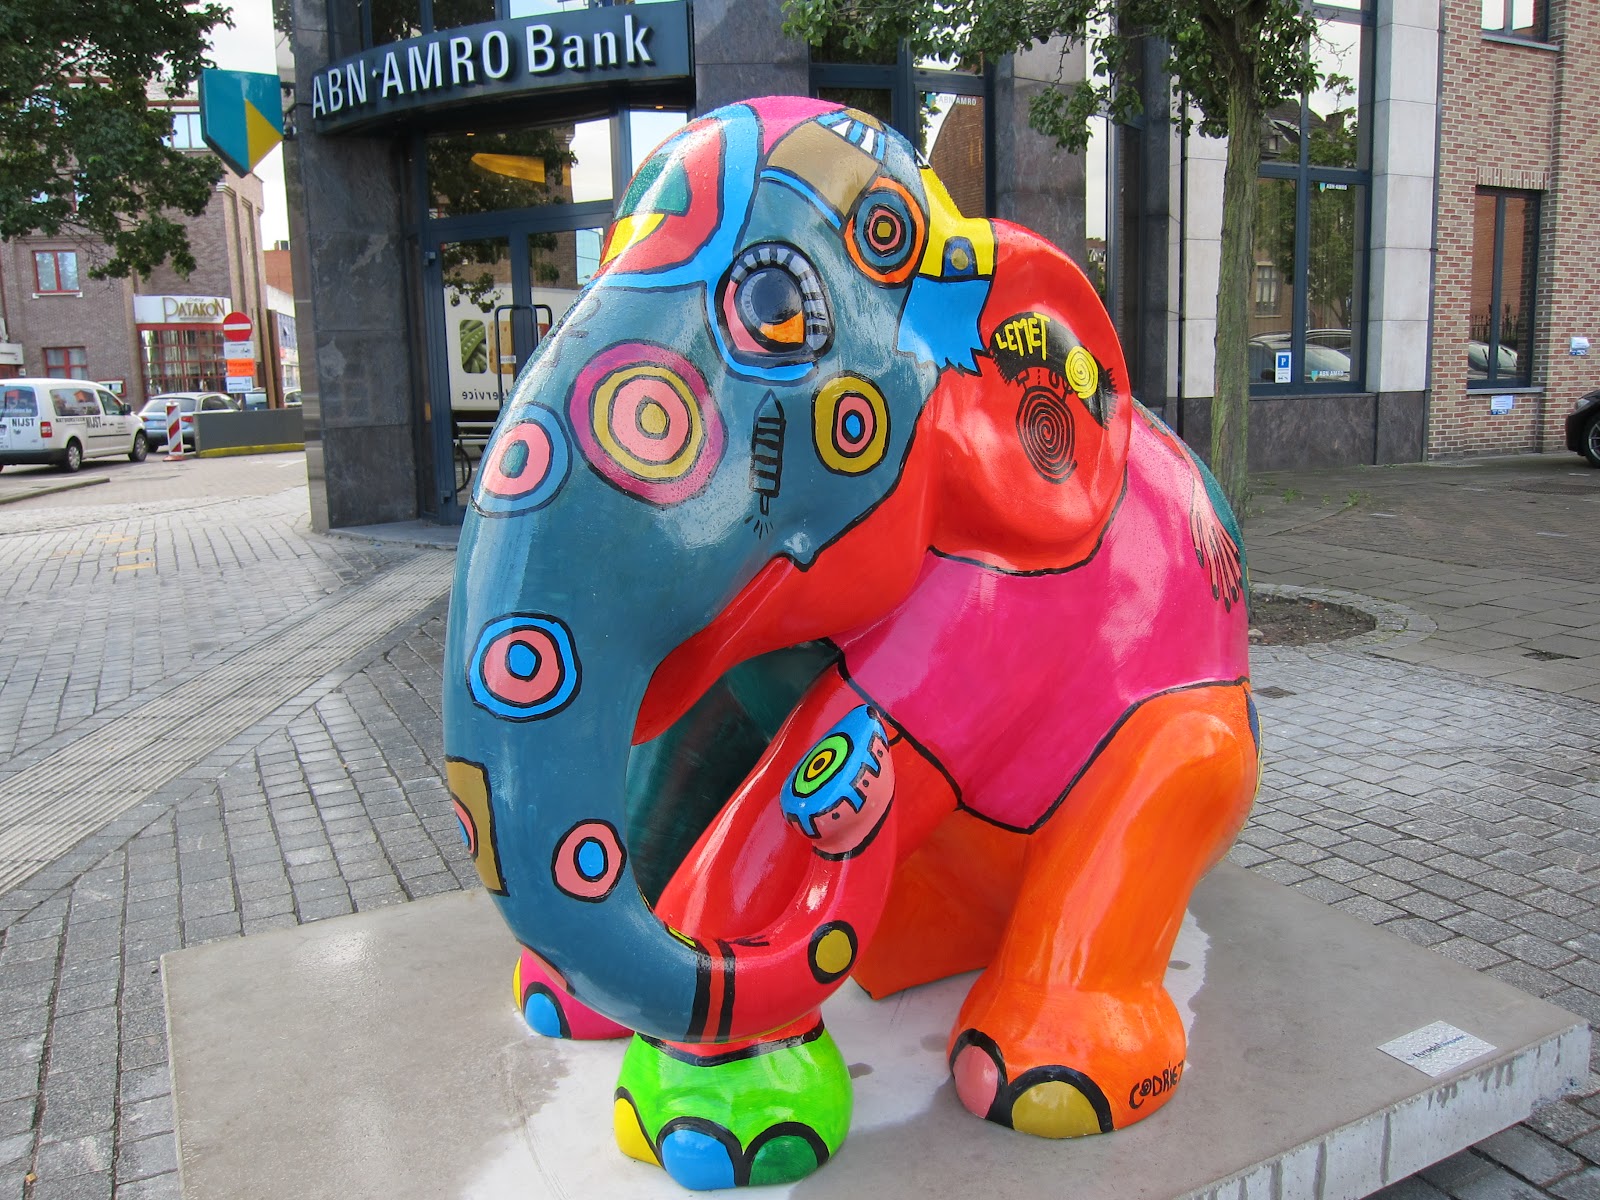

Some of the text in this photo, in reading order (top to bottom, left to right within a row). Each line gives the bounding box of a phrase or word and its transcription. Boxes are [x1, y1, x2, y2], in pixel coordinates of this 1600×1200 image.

[526, 14, 652, 73] Bank
[939, 95, 977, 106] ABN AMRO
[995, 312, 1051, 361] LEMET
[12, 418, 35, 427] NIJST
